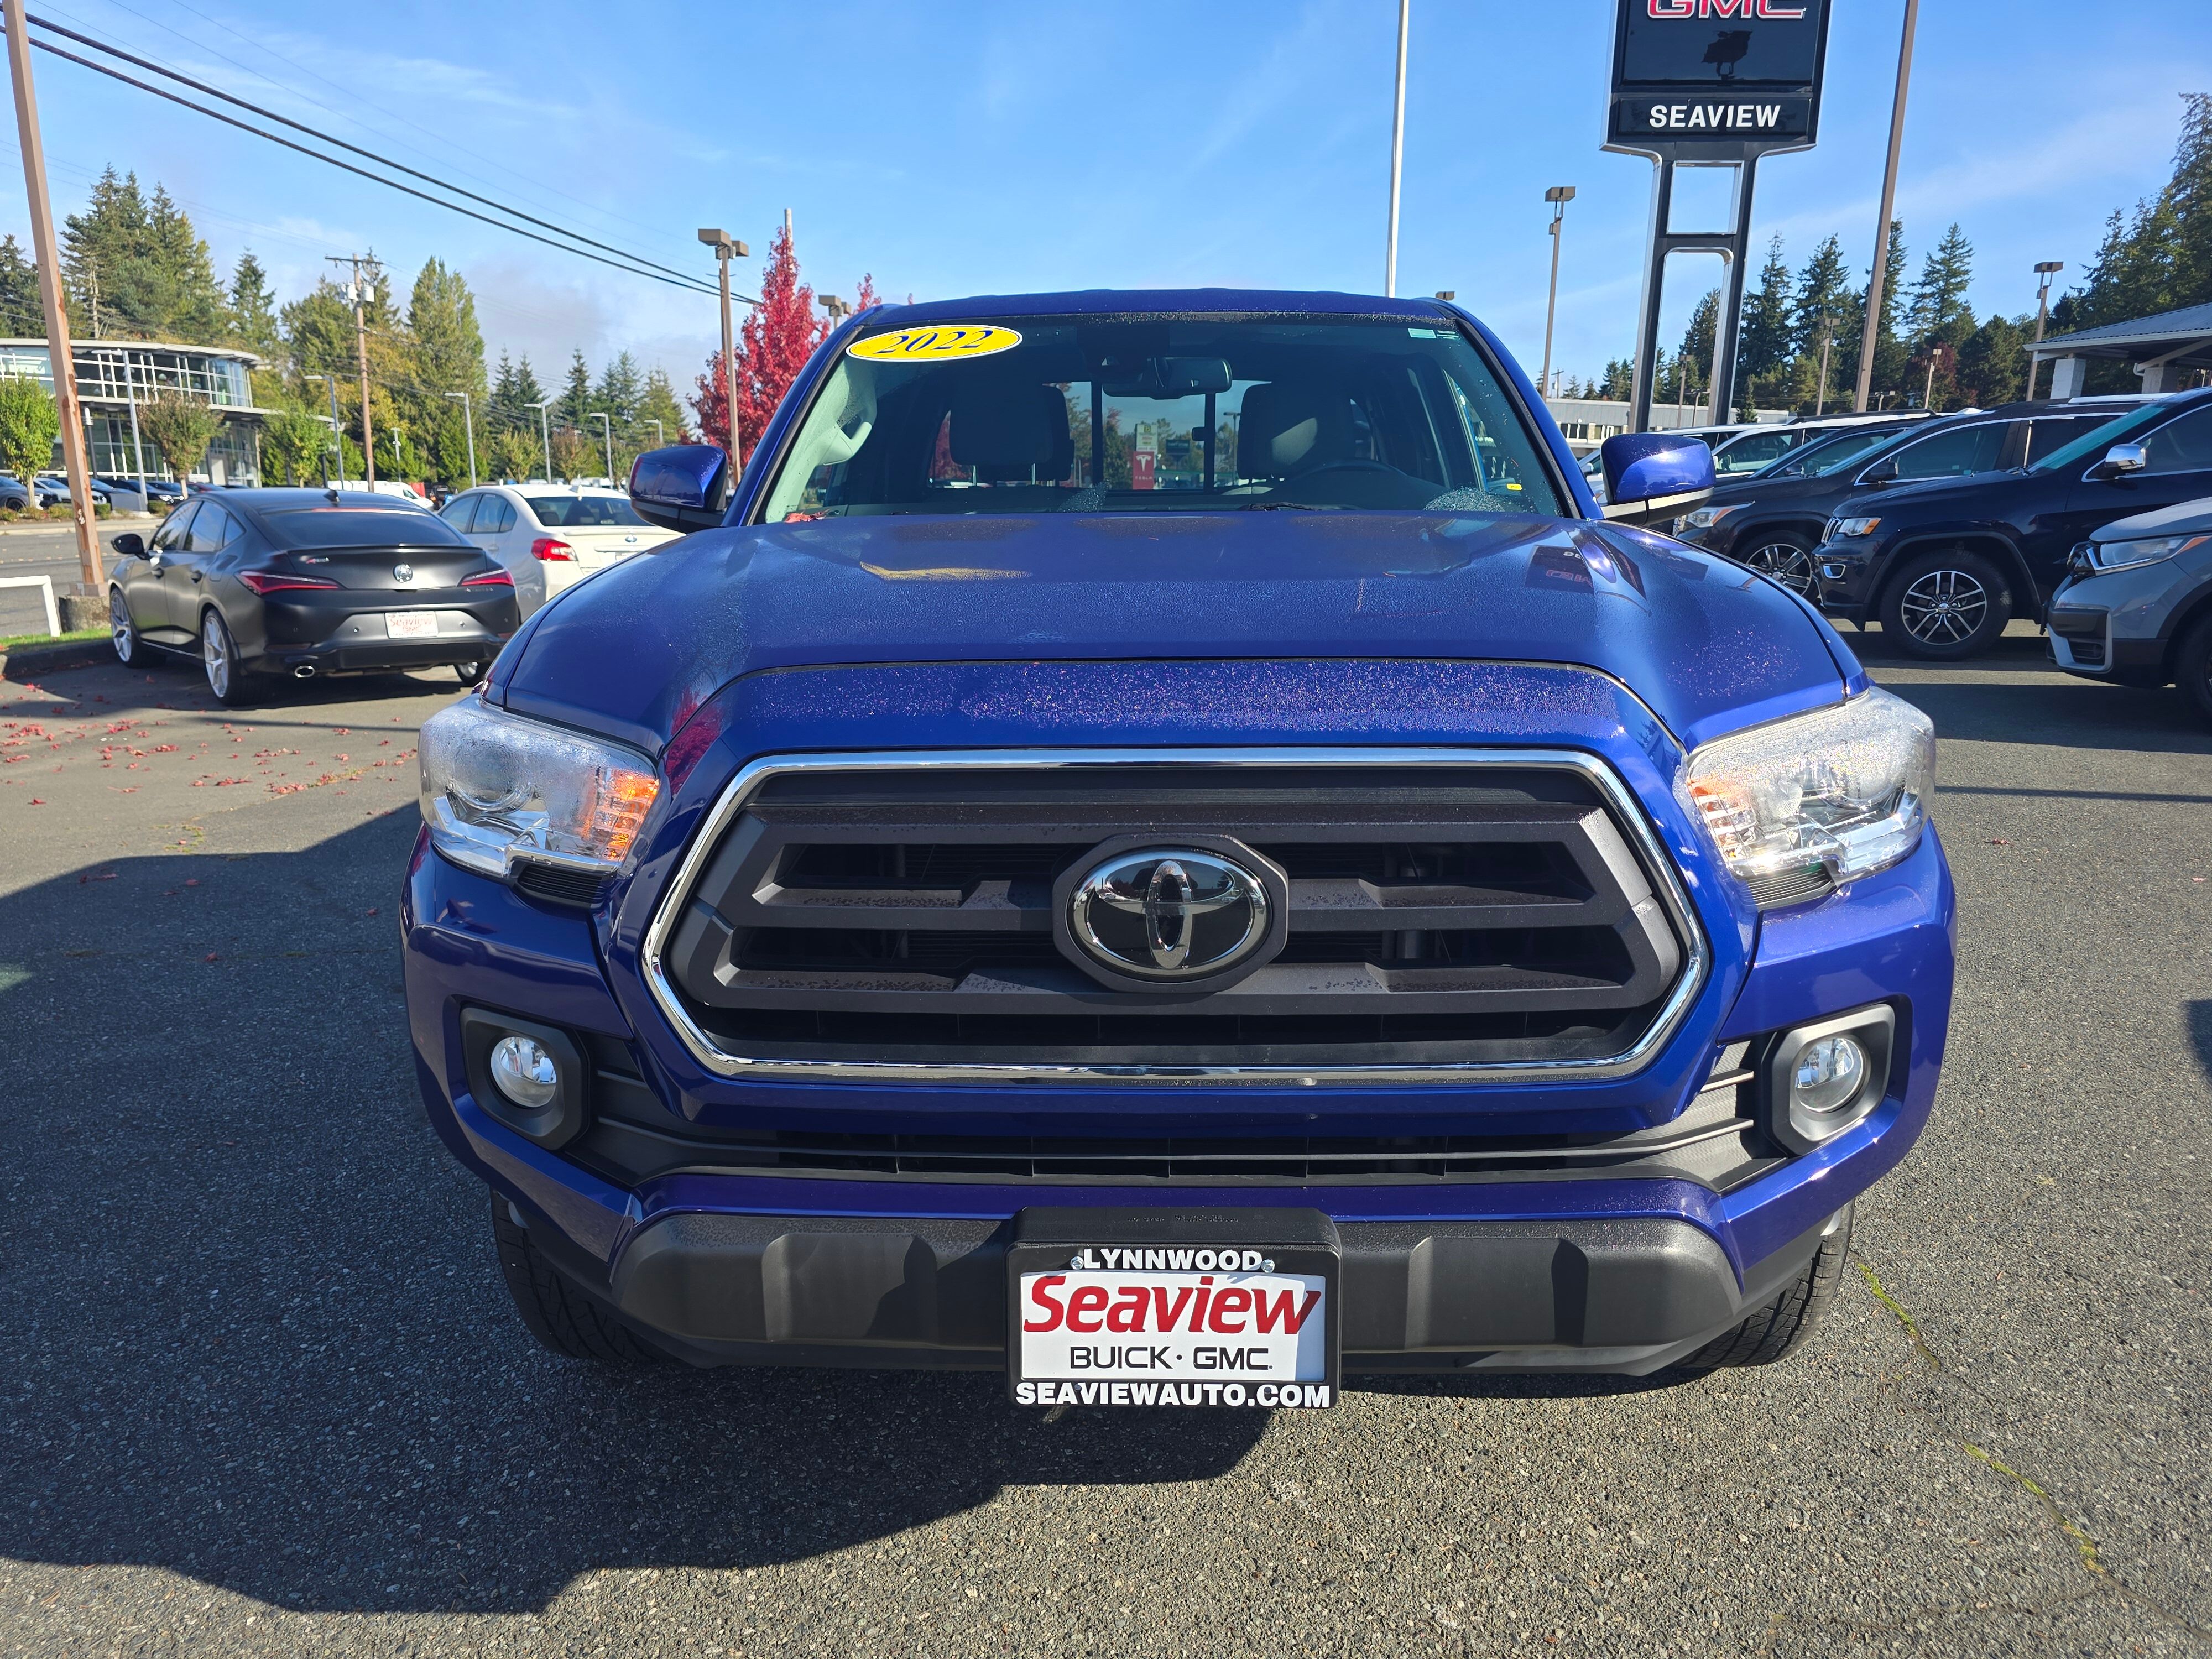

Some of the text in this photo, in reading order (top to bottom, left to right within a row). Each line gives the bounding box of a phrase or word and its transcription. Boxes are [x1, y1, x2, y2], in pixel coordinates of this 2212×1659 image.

[1650, 105, 1781, 128] SEAVIEW
[873, 330, 993, 354] 2022
[1084, 1248, 1263, 1271] LYNNWOOD
[1023, 1275, 1322, 1335] Seaview
[1070, 1346, 1273, 1370] BUICK GMC
[1016, 1382, 1329, 1408] SEAVIEWAUTO.COM
